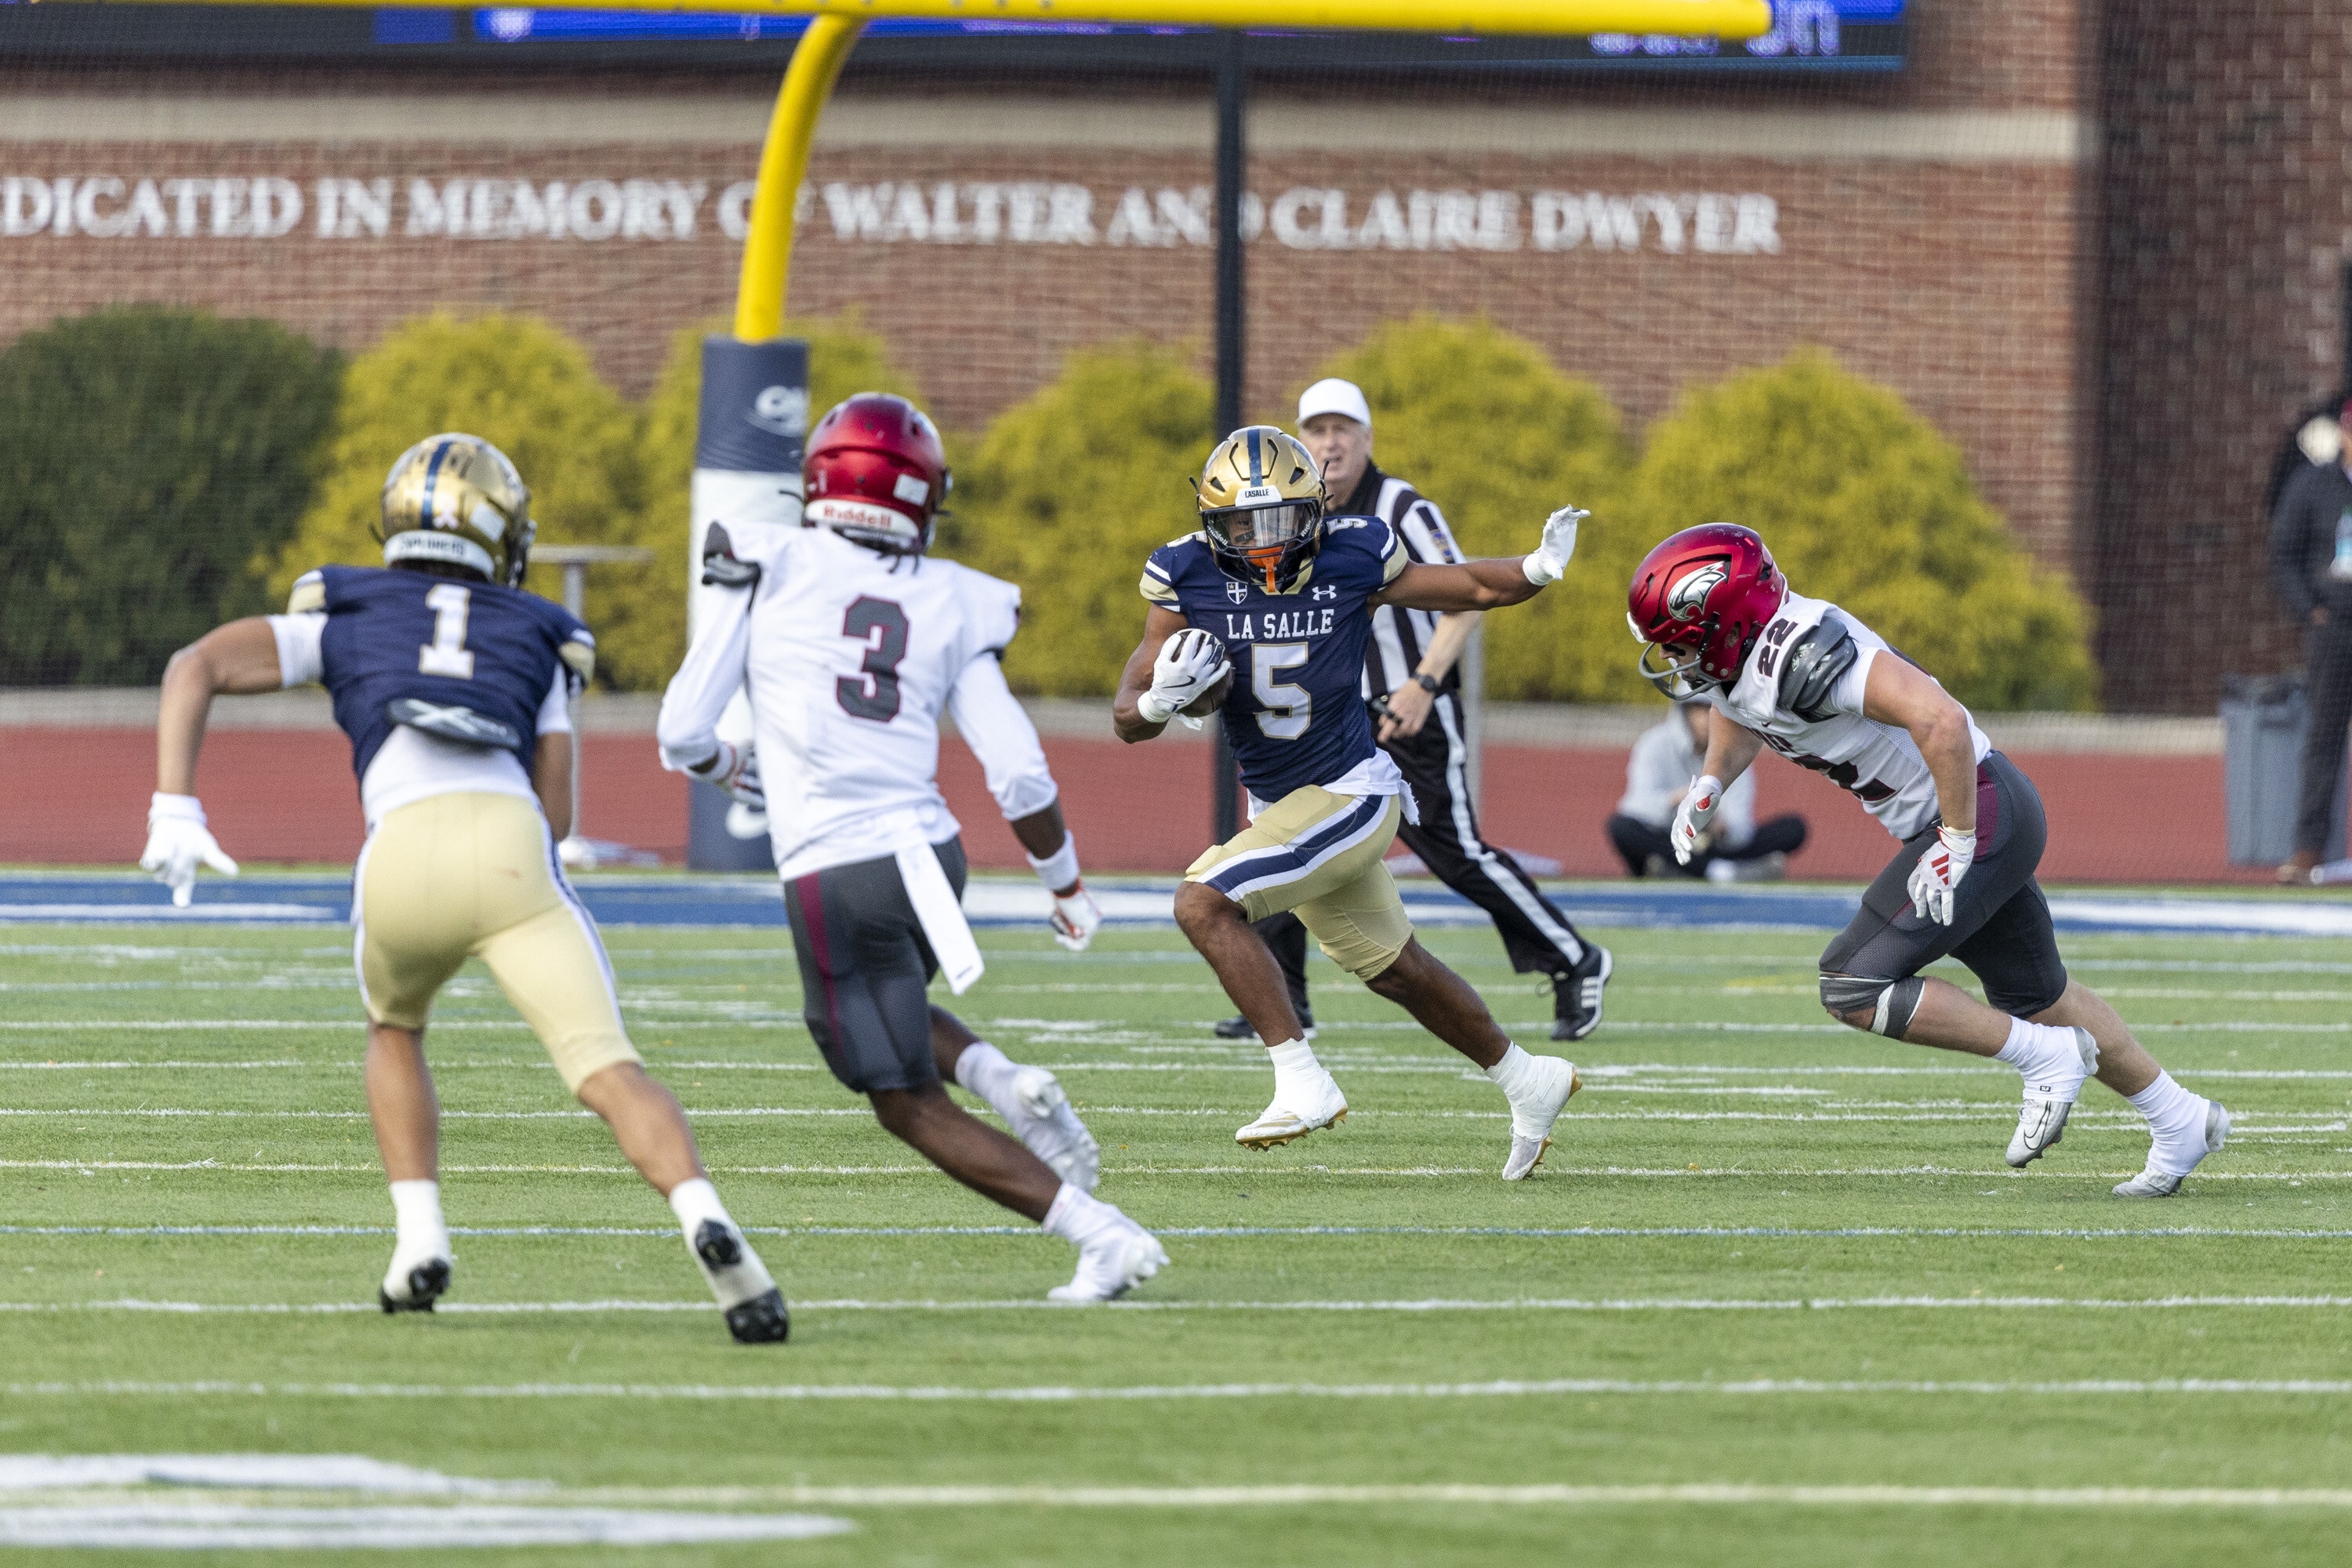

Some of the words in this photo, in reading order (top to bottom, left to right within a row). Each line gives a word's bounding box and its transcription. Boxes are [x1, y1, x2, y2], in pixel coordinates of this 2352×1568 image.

[316, 176, 392, 238] IN
[405, 177, 708, 241] MEMORY
[823, 180, 1098, 245] WALTER
[1269, 185, 1523, 252] CLAIRE
[1531, 190, 1782, 255] DWYER
[1244, 488, 1270, 499] LASALLE
[1327, 517, 1368, 535] 5
[418, 583, 475, 680] 1
[836, 594, 909, 723] 3
[1226, 614, 1254, 639] LA
[1263, 608, 1334, 640] SALLE
[1757, 617, 1799, 678] 22
[1251, 641, 1312, 740] 5
